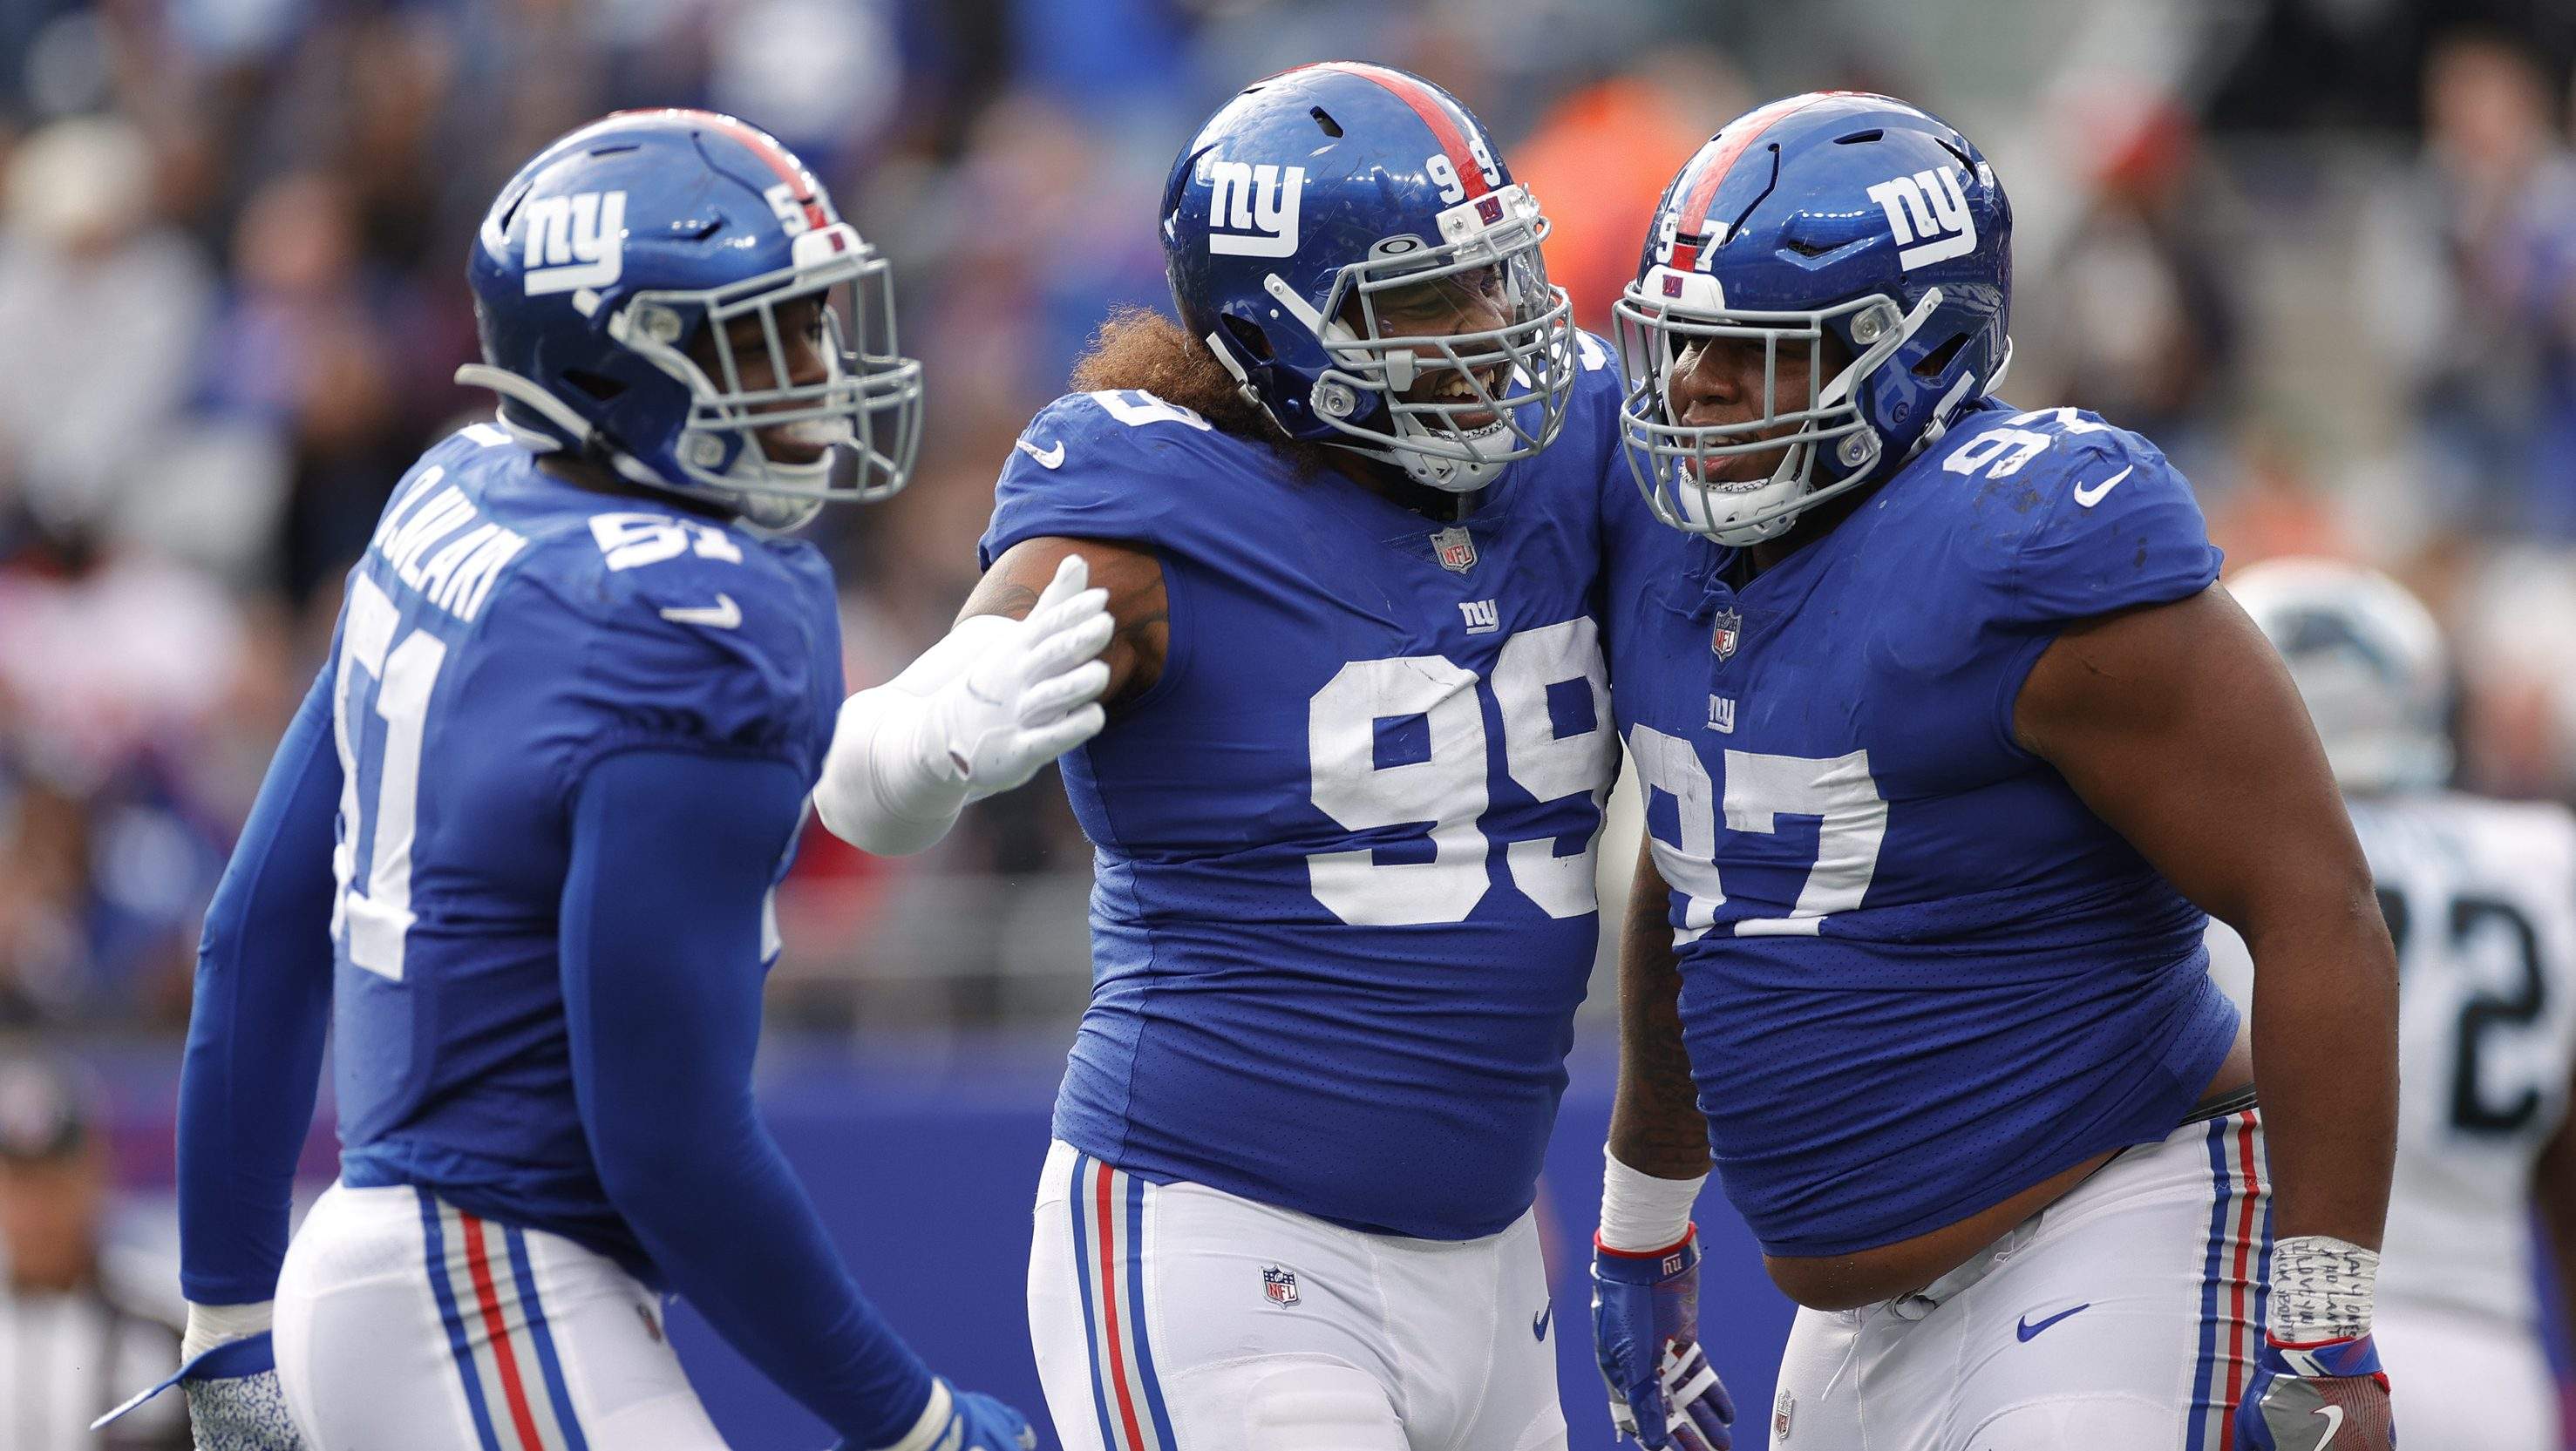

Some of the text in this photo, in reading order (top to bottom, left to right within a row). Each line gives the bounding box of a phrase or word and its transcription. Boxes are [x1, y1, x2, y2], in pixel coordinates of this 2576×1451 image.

[1425, 139, 1500, 204] 99
[523, 190, 627, 296] ny
[1210, 161, 1305, 258] ny
[1656, 212, 1730, 272] 97
[1866, 166, 1977, 272] ny
[1943, 407, 2111, 479] 97
[588, 512, 744, 573] 51
[1458, 599, 1499, 635] ny
[1706, 694, 1735, 735] ny
[1306, 615, 1613, 926] 99
[1628, 722, 1889, 947] 97
[2377, 887, 2544, 1130] 2
[2295, 1256, 2315, 1296] LOVE
